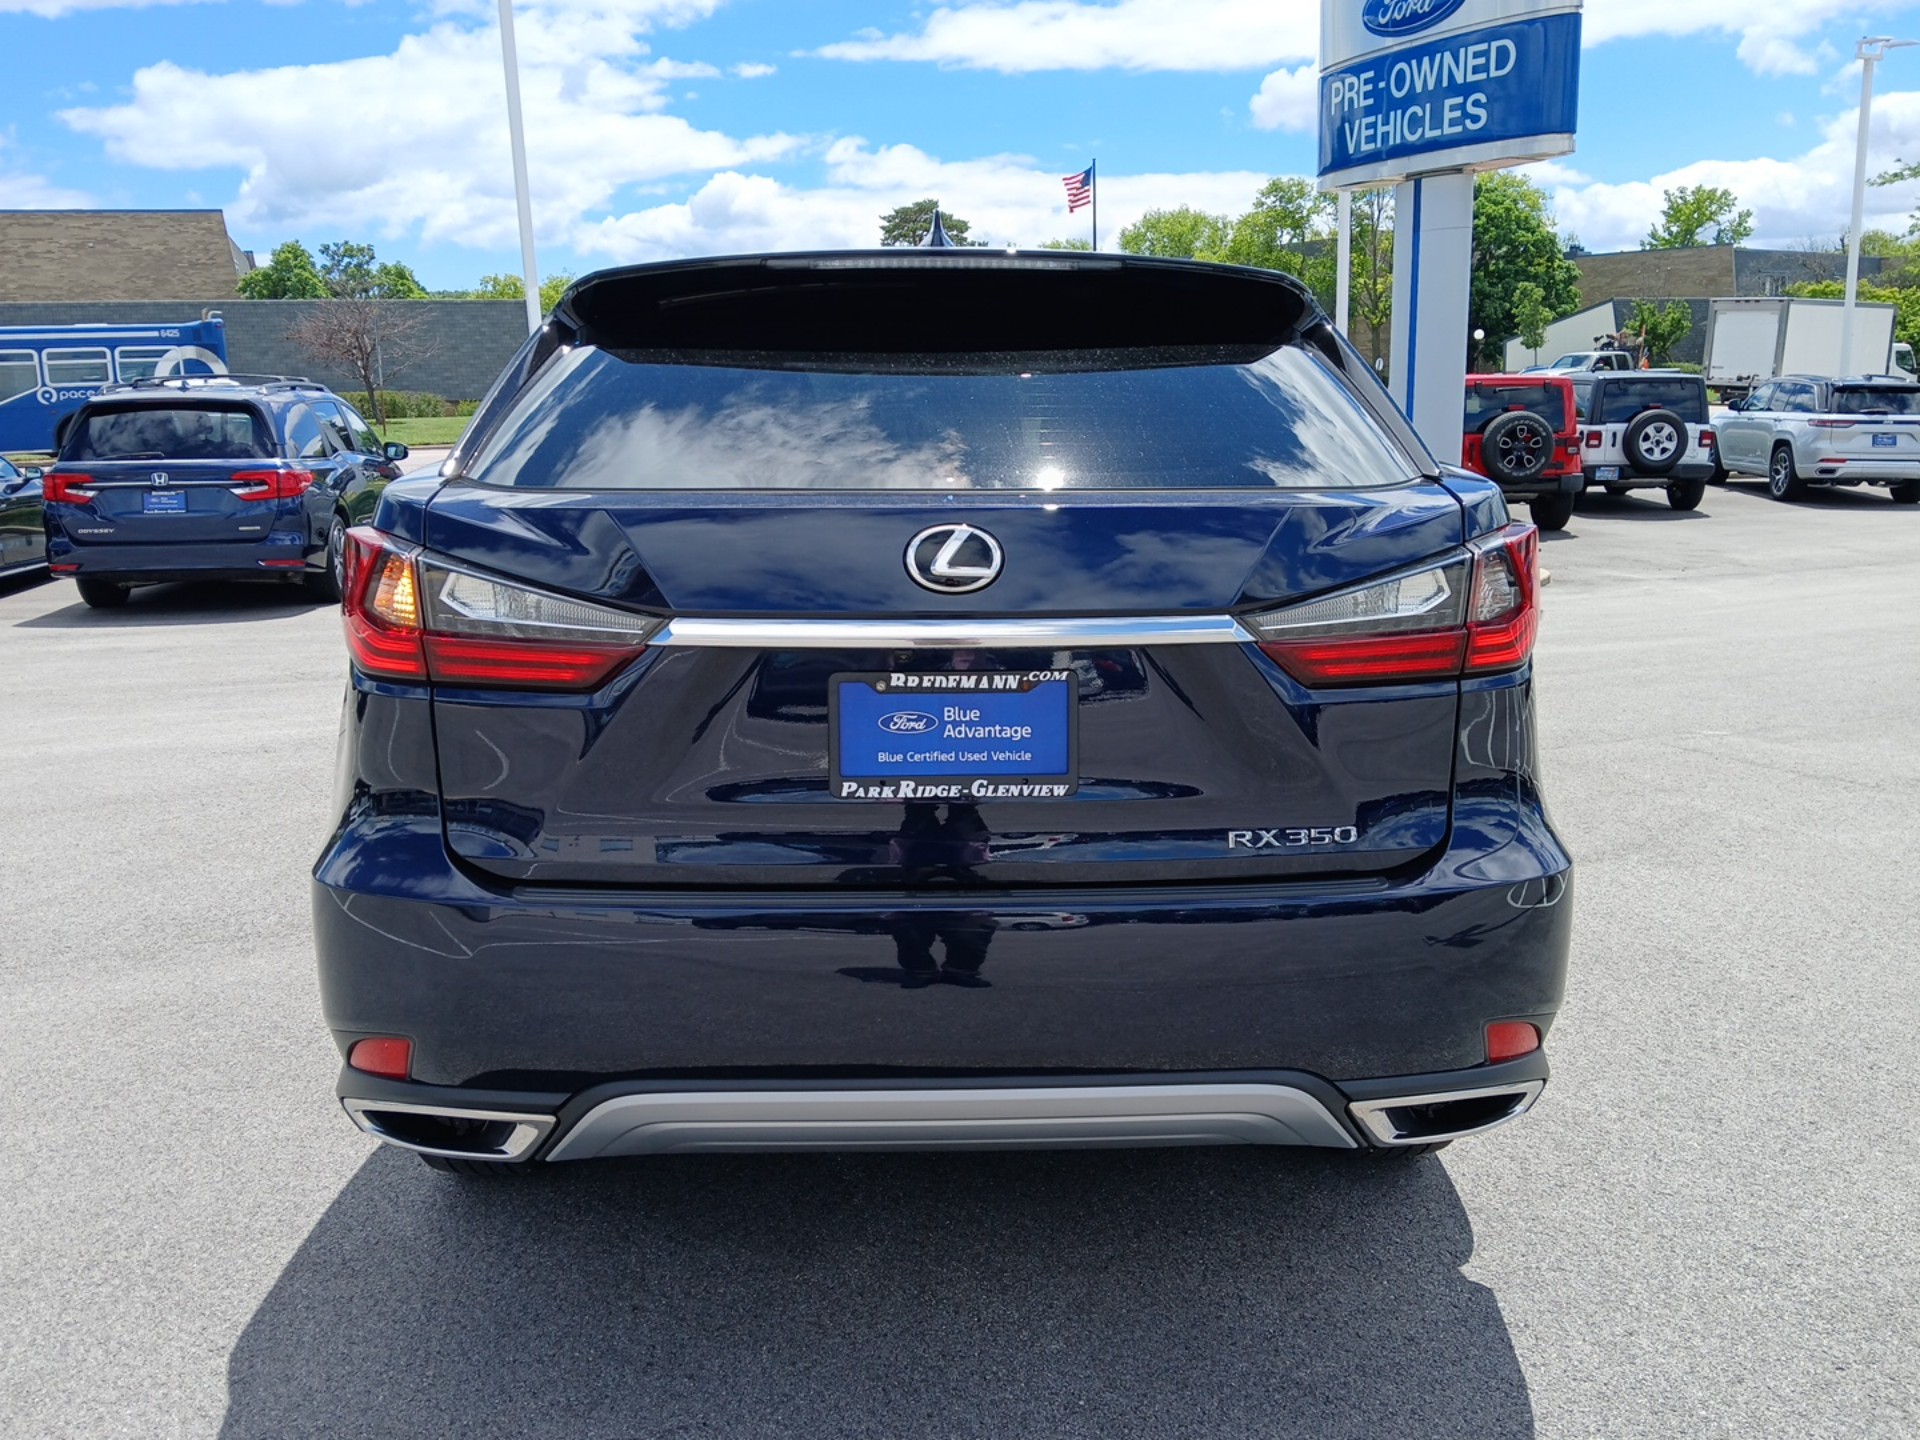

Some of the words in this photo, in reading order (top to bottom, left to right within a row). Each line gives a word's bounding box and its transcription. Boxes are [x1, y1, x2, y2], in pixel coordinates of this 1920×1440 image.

[1330, 39, 1516, 115] PRE-OWNED
[1344, 93, 1488, 154] VEHICLES
[160, 329, 180, 337] 6425
[59, 389, 96, 400] pace
[943, 706, 981, 721] Blue
[889, 715, 927, 730] Ford
[943, 723, 1032, 741] Advantage
[878, 752, 904, 762] Blue
[906, 751, 956, 762] Certified
[959, 751, 988, 761] Used
[991, 750, 1032, 761] Vehicle
